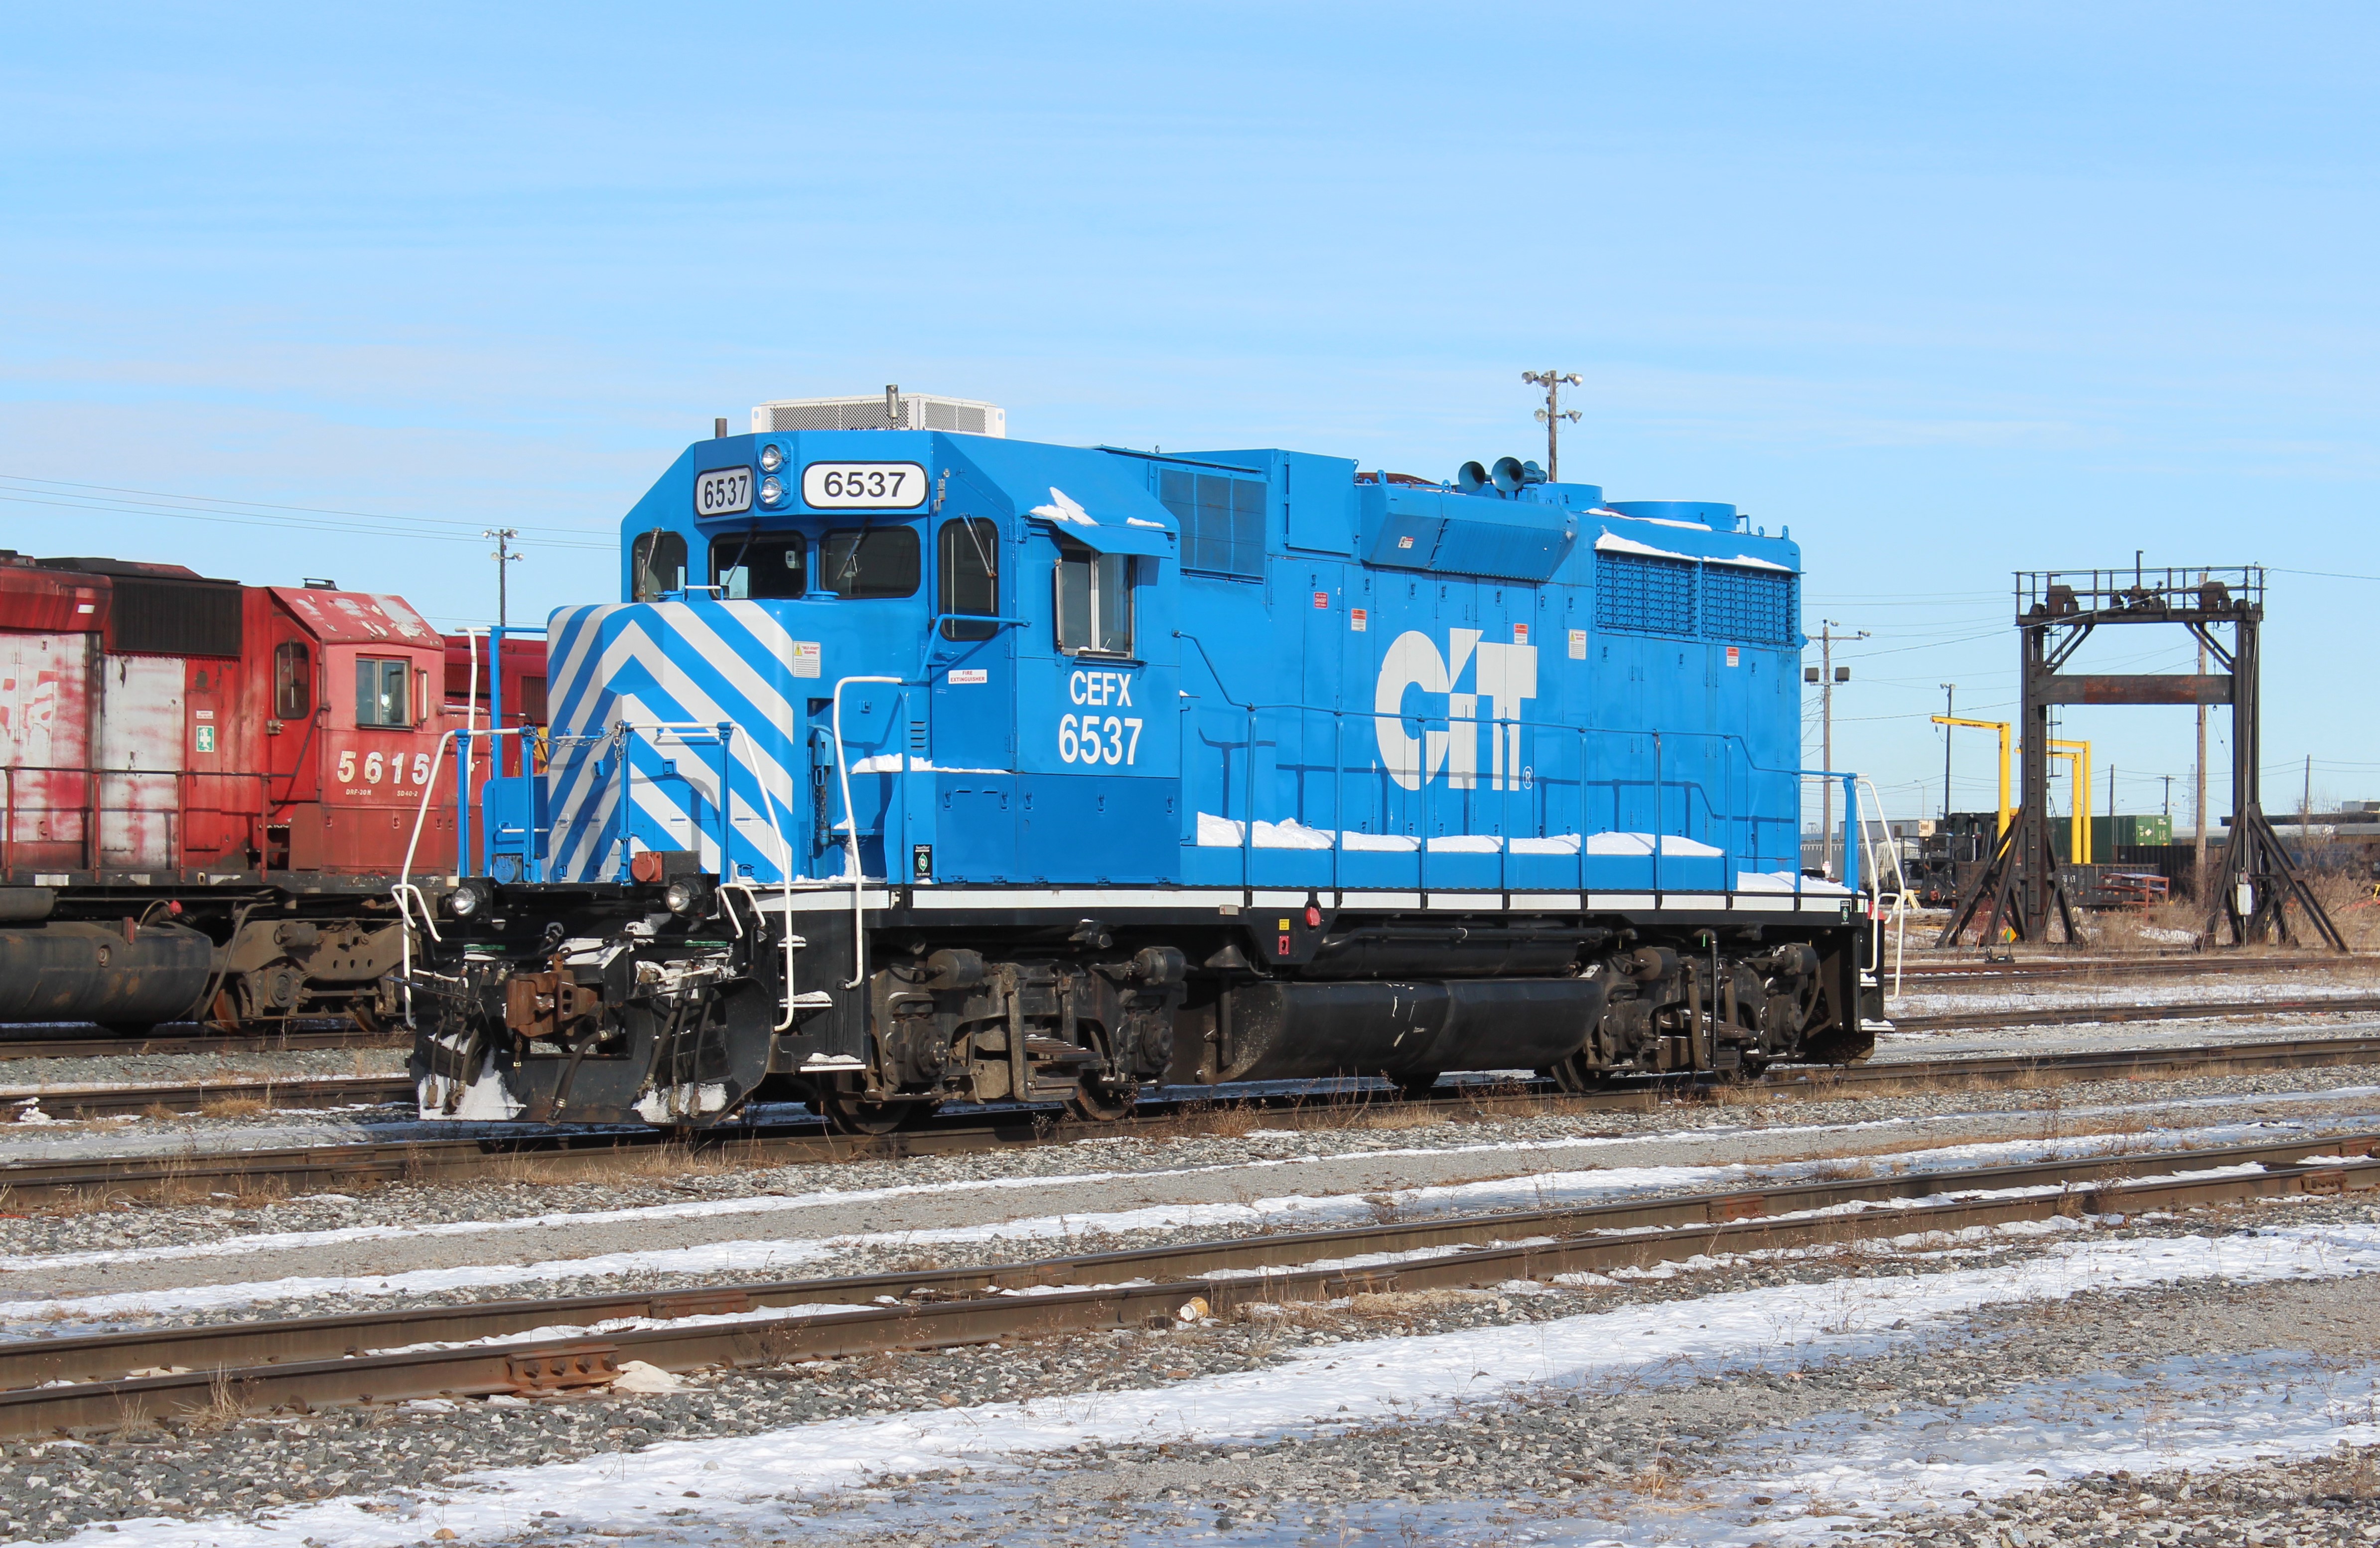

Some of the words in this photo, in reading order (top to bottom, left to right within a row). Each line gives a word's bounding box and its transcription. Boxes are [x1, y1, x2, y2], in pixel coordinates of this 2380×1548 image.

[704, 475, 747, 509] 6537
[824, 471, 906, 497] 6537
[1070, 670, 1132, 706] CEFX
[1375, 628, 1538, 791] CIT
[1059, 713, 1142, 765] 6537
[337, 750, 430, 785] 5615
